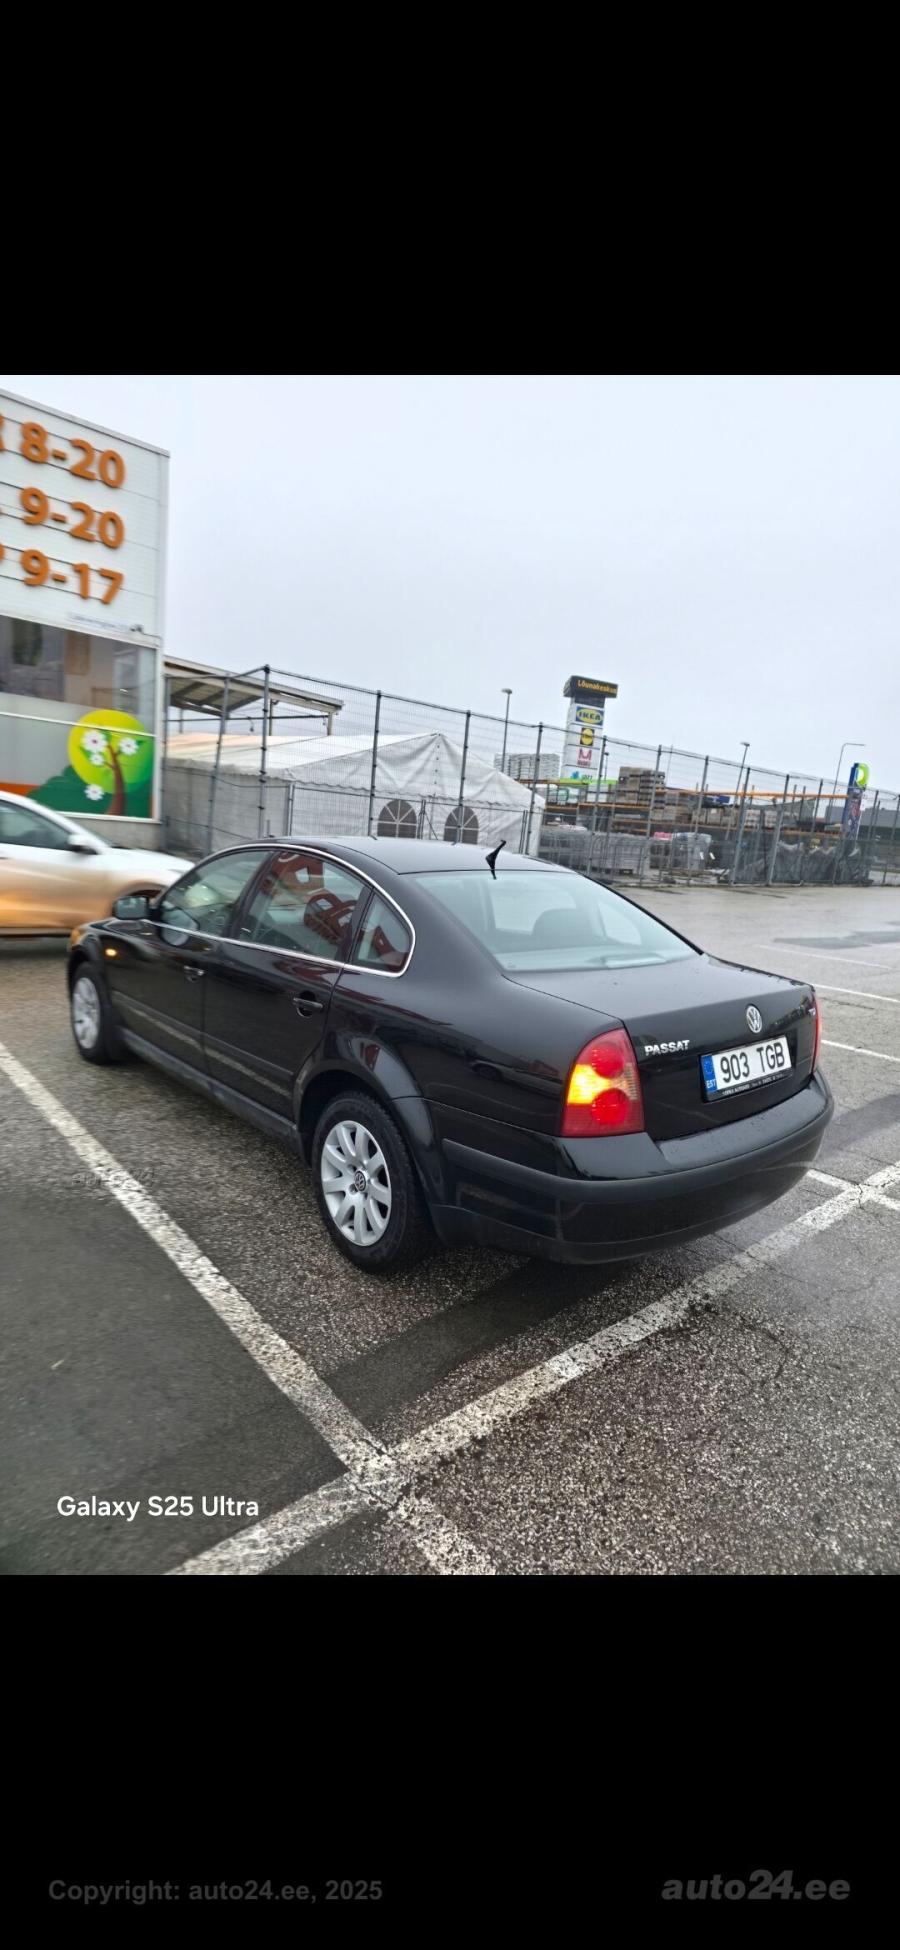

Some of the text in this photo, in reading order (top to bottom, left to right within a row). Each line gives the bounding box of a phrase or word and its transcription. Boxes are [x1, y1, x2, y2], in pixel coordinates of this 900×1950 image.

[20, 422, 125, 488] 8-20
[20, 487, 125, 549] 9-20
[20, 549, 124, 605] 9-17
[579, 711, 601, 721] IKEA
[644, 1039, 690, 1056] PASSAT
[720, 1051, 750, 1084] 903
[756, 1041, 785, 1073] TGB
[706, 1078, 717, 1089] EST
